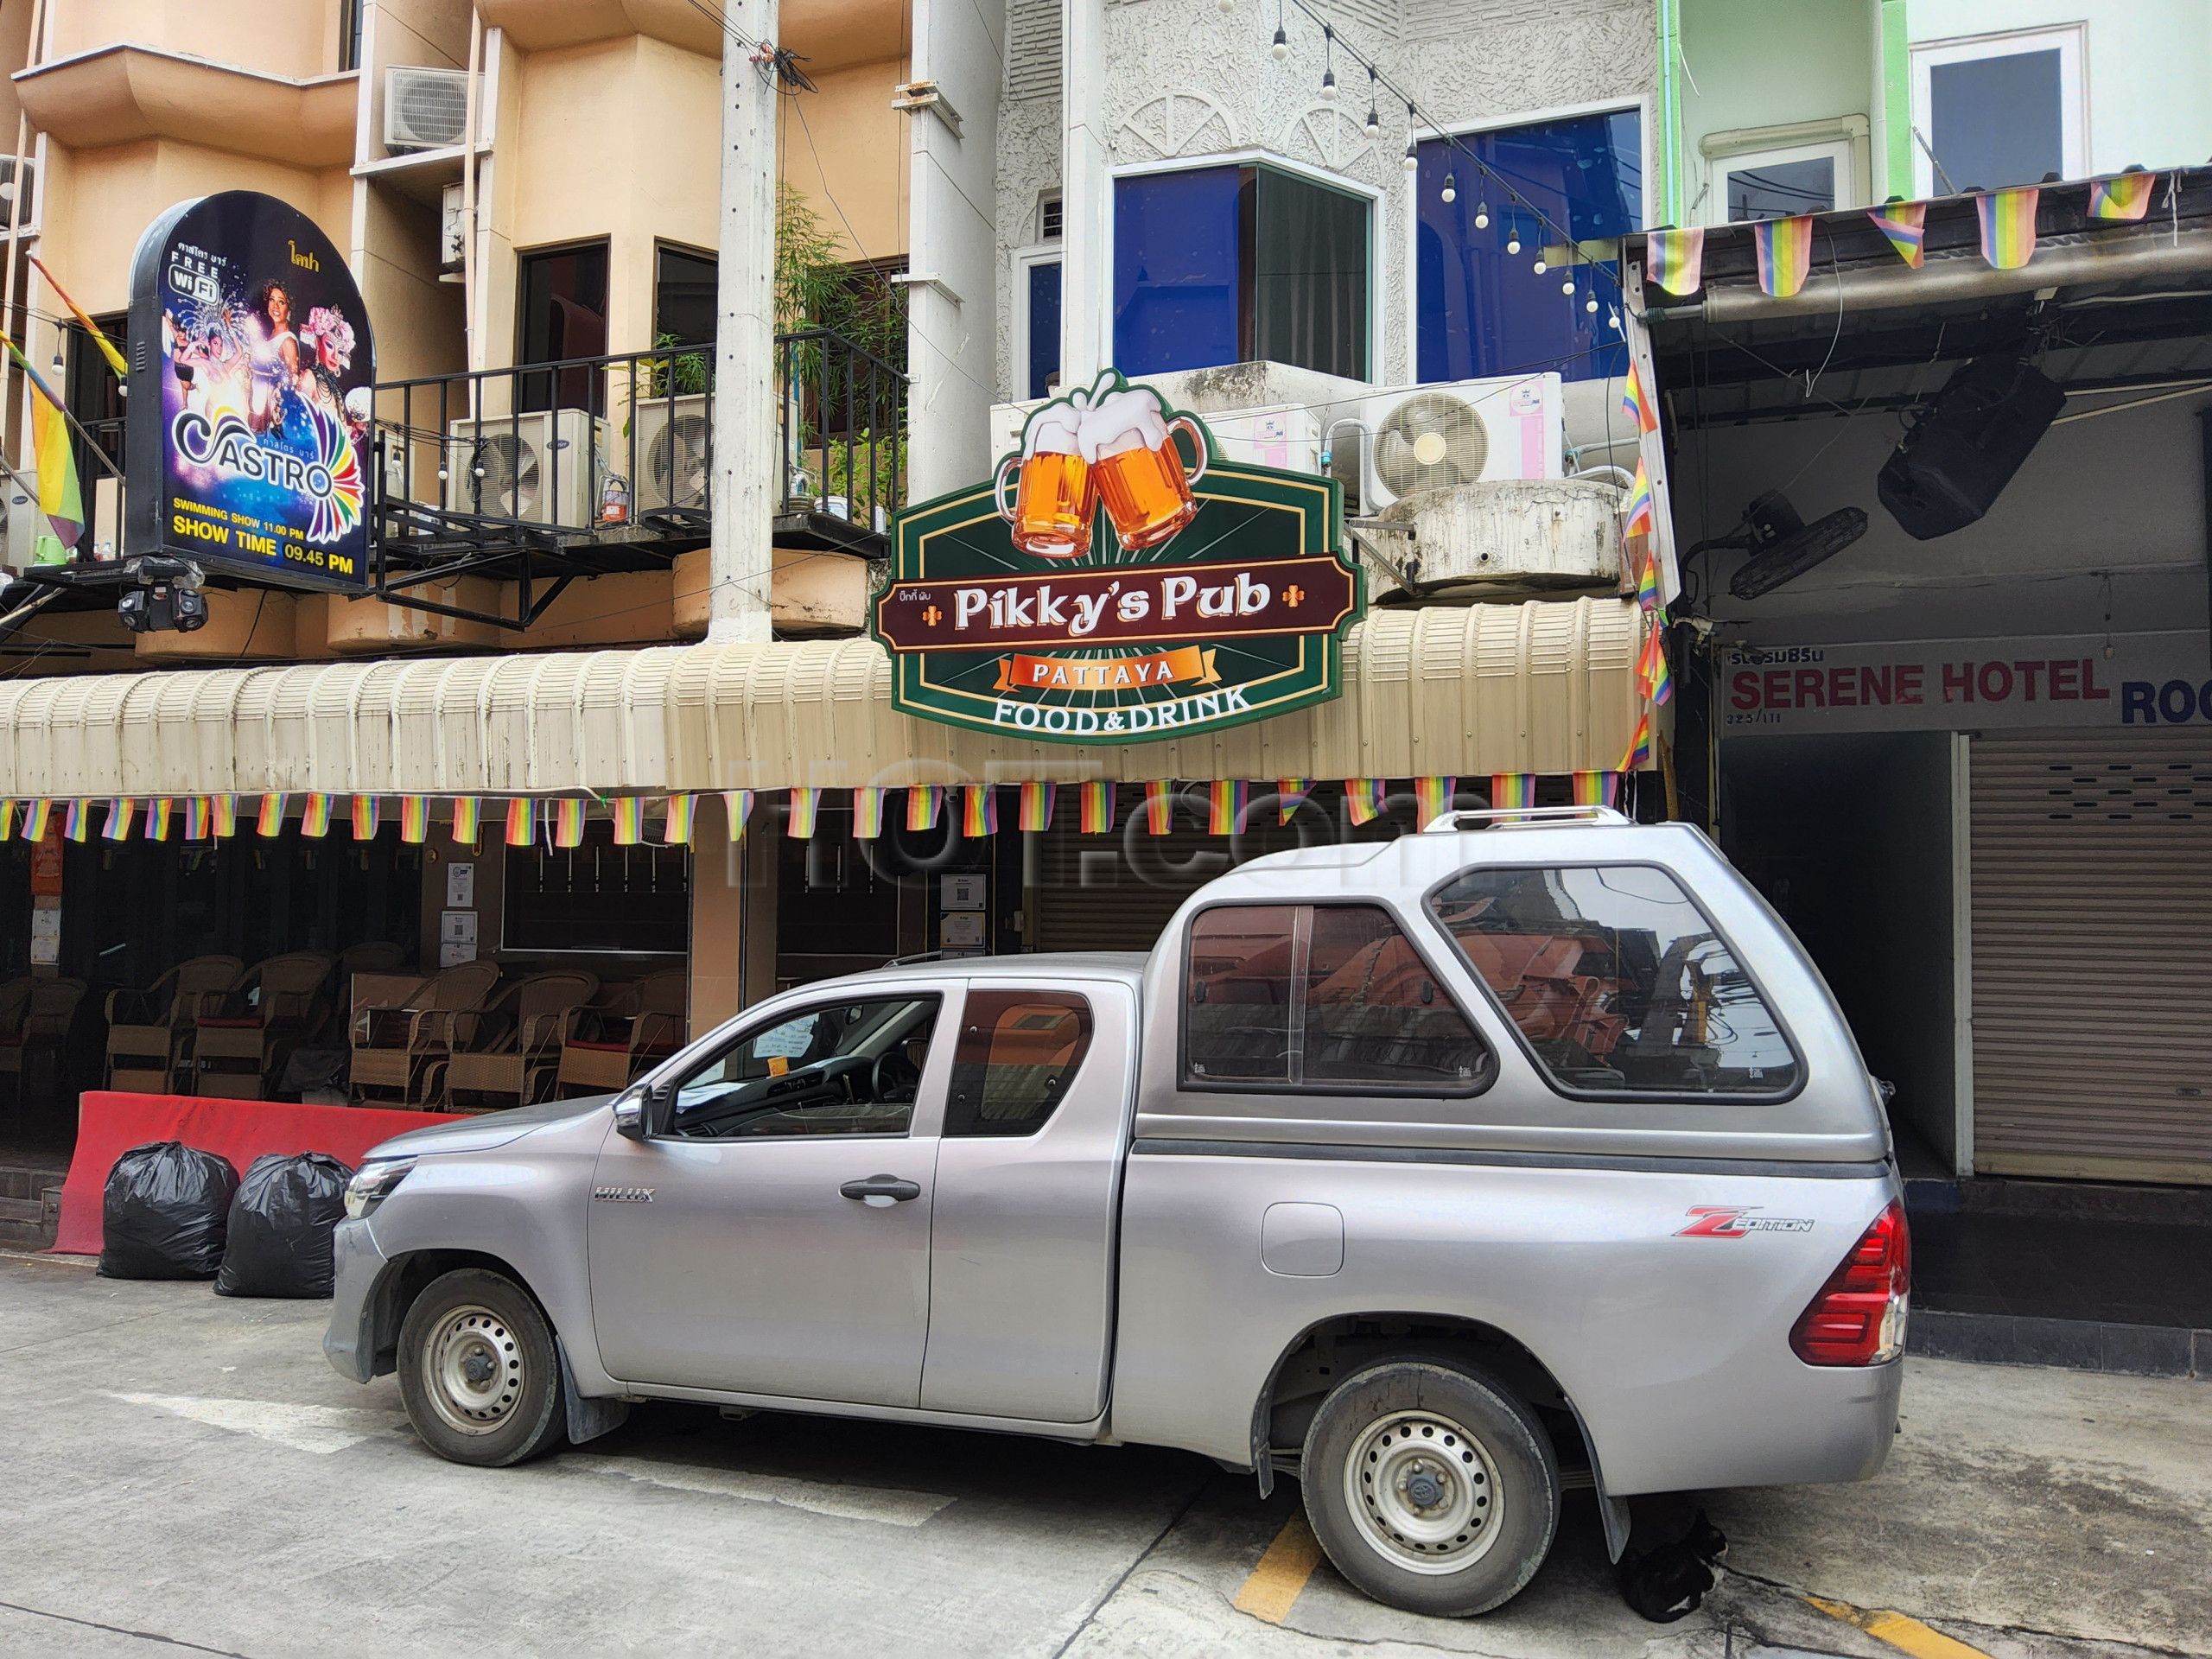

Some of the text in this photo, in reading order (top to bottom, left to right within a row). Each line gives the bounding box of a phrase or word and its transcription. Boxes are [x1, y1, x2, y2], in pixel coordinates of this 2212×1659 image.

[171, 250, 219, 279] FREE
[174, 409, 334, 499] CASTRO
[173, 498, 304, 540] SWIMMING SHOW 11.00 PM
[173, 515, 353, 574] SHOW TIME 09.45 PM
[955, 572, 1271, 637] Pikky's Pub
[1033, 659, 1174, 683] PATTAYA
[1731, 658, 2110, 710] SERENE HOTEL
[594, 1186, 655, 1202] HILUX
